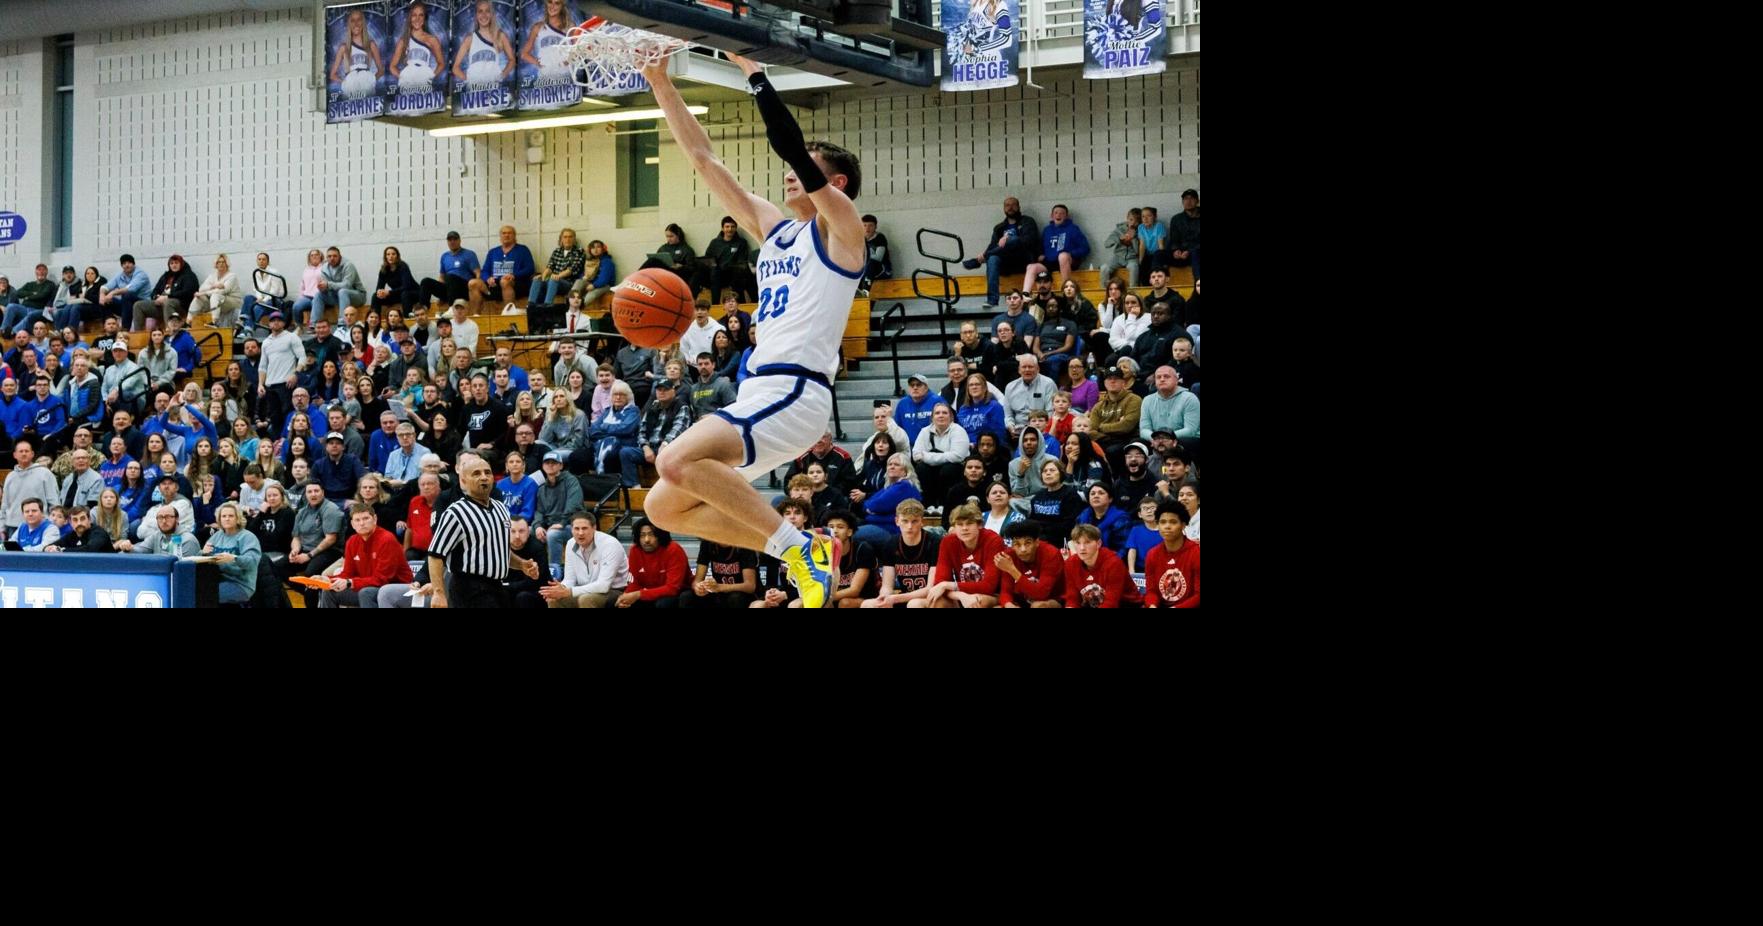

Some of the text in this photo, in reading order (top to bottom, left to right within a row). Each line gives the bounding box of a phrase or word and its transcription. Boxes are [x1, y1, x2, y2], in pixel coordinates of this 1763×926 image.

[1110, 40, 1140, 50] Mollie
[965, 54, 997, 65] Sophia
[1105, 48, 1151, 69] PAIZ
[953, 60, 1008, 82] HEGGE
[390, 92, 442, 111] JORDAN
[462, 88, 508, 109] WIESE
[759, 255, 801, 281] TITANS
[758, 284, 790, 322] 20
